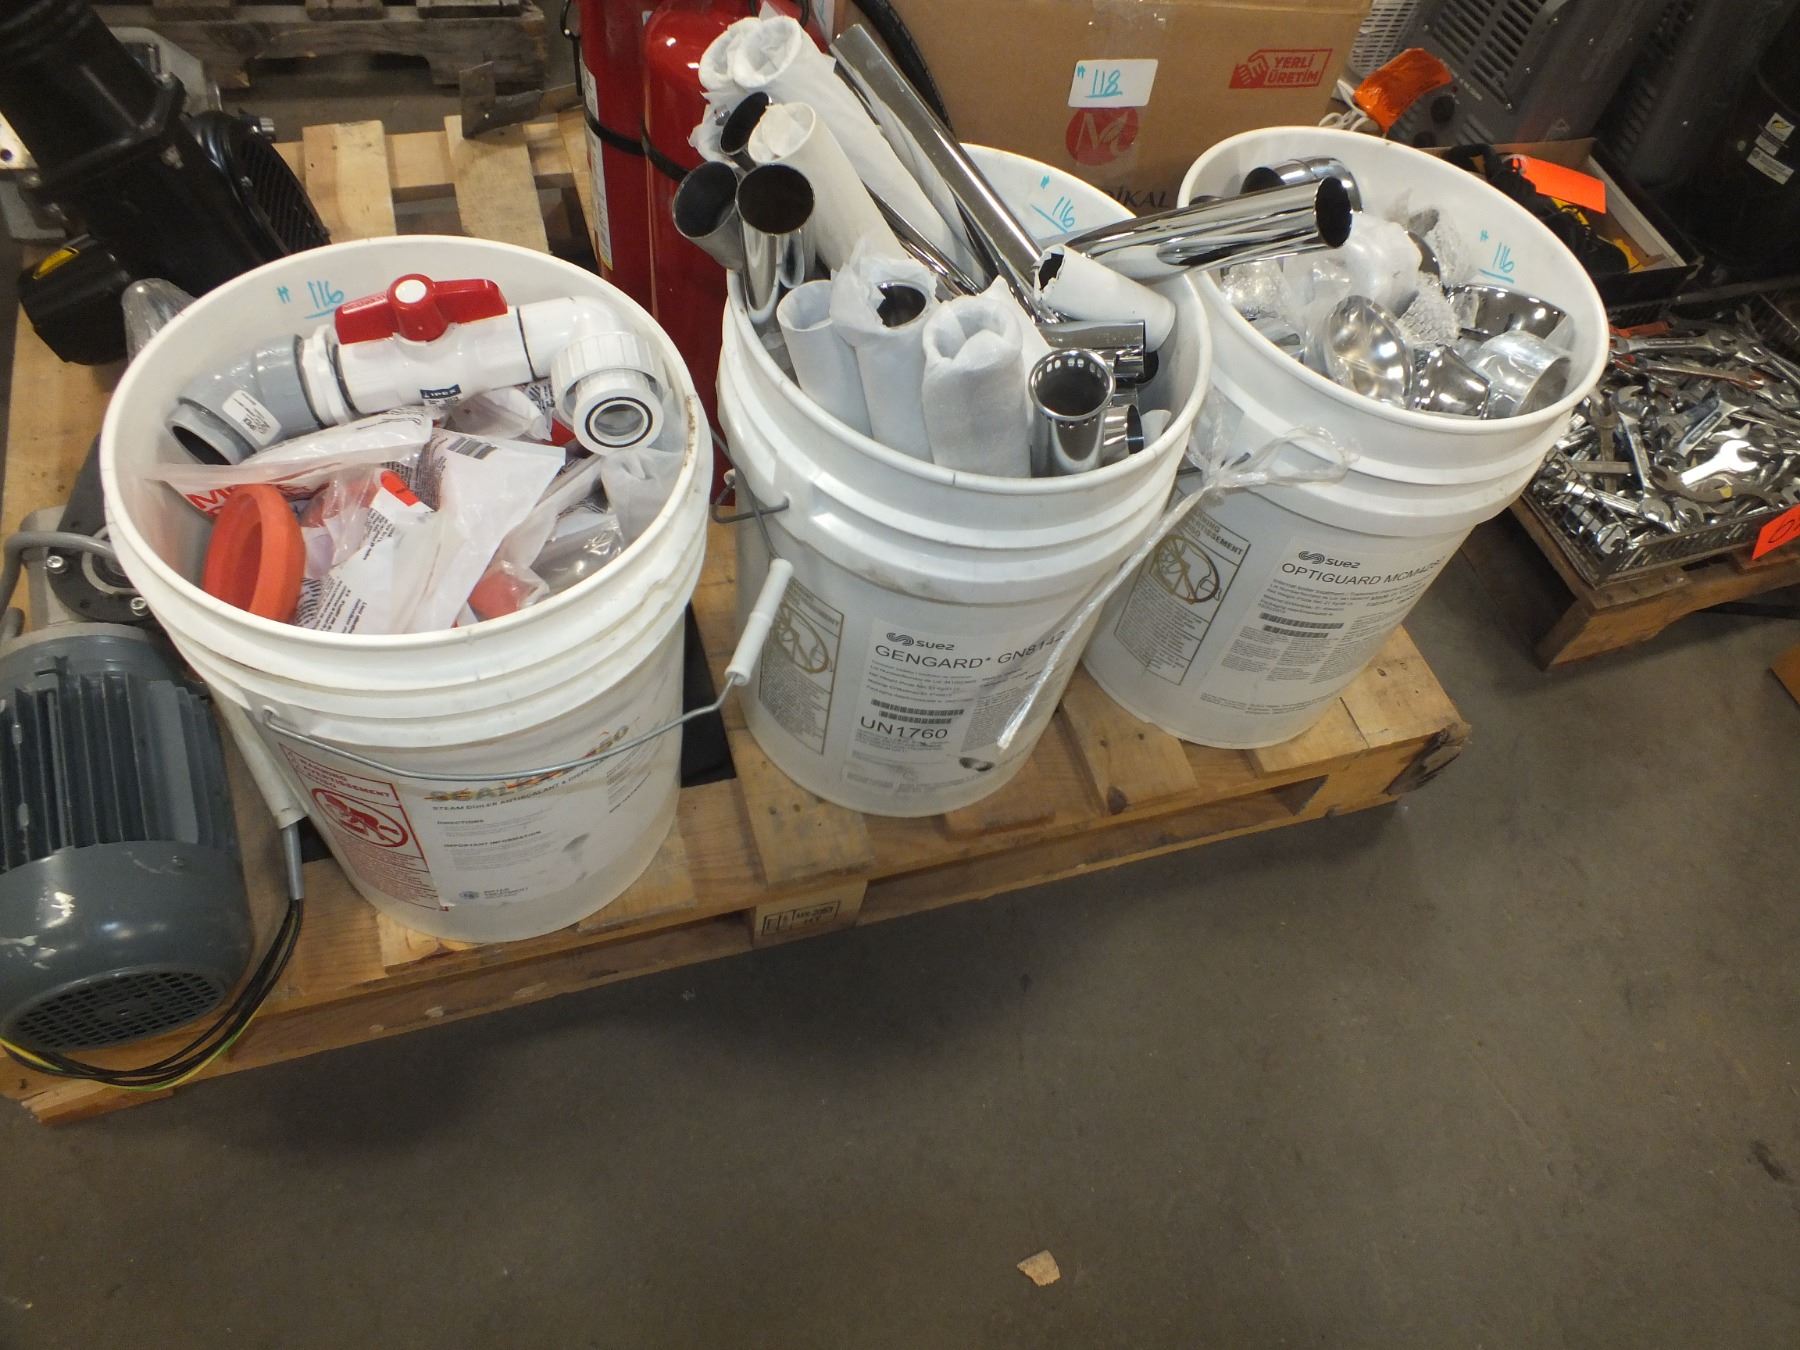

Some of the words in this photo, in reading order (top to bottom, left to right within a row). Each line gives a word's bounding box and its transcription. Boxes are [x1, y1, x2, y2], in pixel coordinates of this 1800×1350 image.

[1273, 54, 1315, 67] YERLİ
[1090, 69, 1122, 97] 118
[1267, 67, 1319, 85] ÜRETİM
[1052, 196, 1075, 228] 116
[1491, 242, 1515, 273] 116
[1281, 563, 1382, 586] OPTIGUARD
[1325, 557, 1361, 569] suez
[915, 639, 955, 651] suez
[860, 715, 949, 740] UN1760
